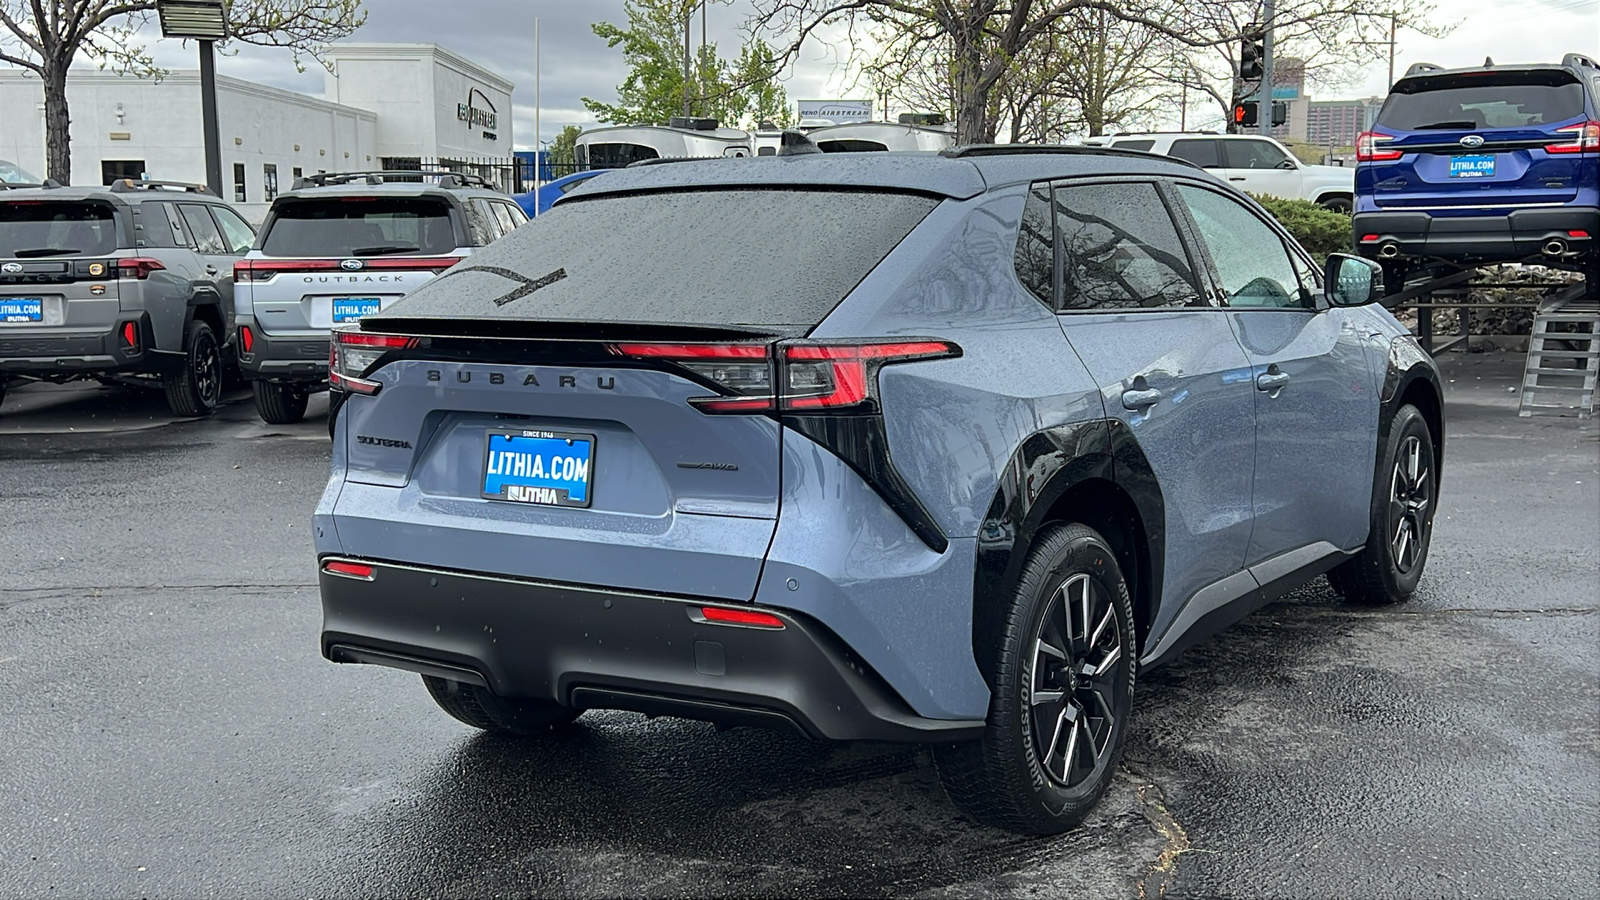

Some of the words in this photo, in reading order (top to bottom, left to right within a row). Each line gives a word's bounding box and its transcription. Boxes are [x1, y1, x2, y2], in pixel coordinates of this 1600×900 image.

[1451, 161, 1494, 170] LITHIA.COM
[334, 305, 379, 315] LITHIA.COM
[426, 369, 615, 390] SUBARU
[357, 435, 413, 449] SOLTERRA
[522, 430, 540, 438] SINCE
[487, 450, 589, 483] LITHIA.COM
[519, 486, 558, 505] LITHIA
[1118, 577, 1137, 697] BRIDGESTONE
[1020, 659, 1044, 793] BRIDGESTONE
